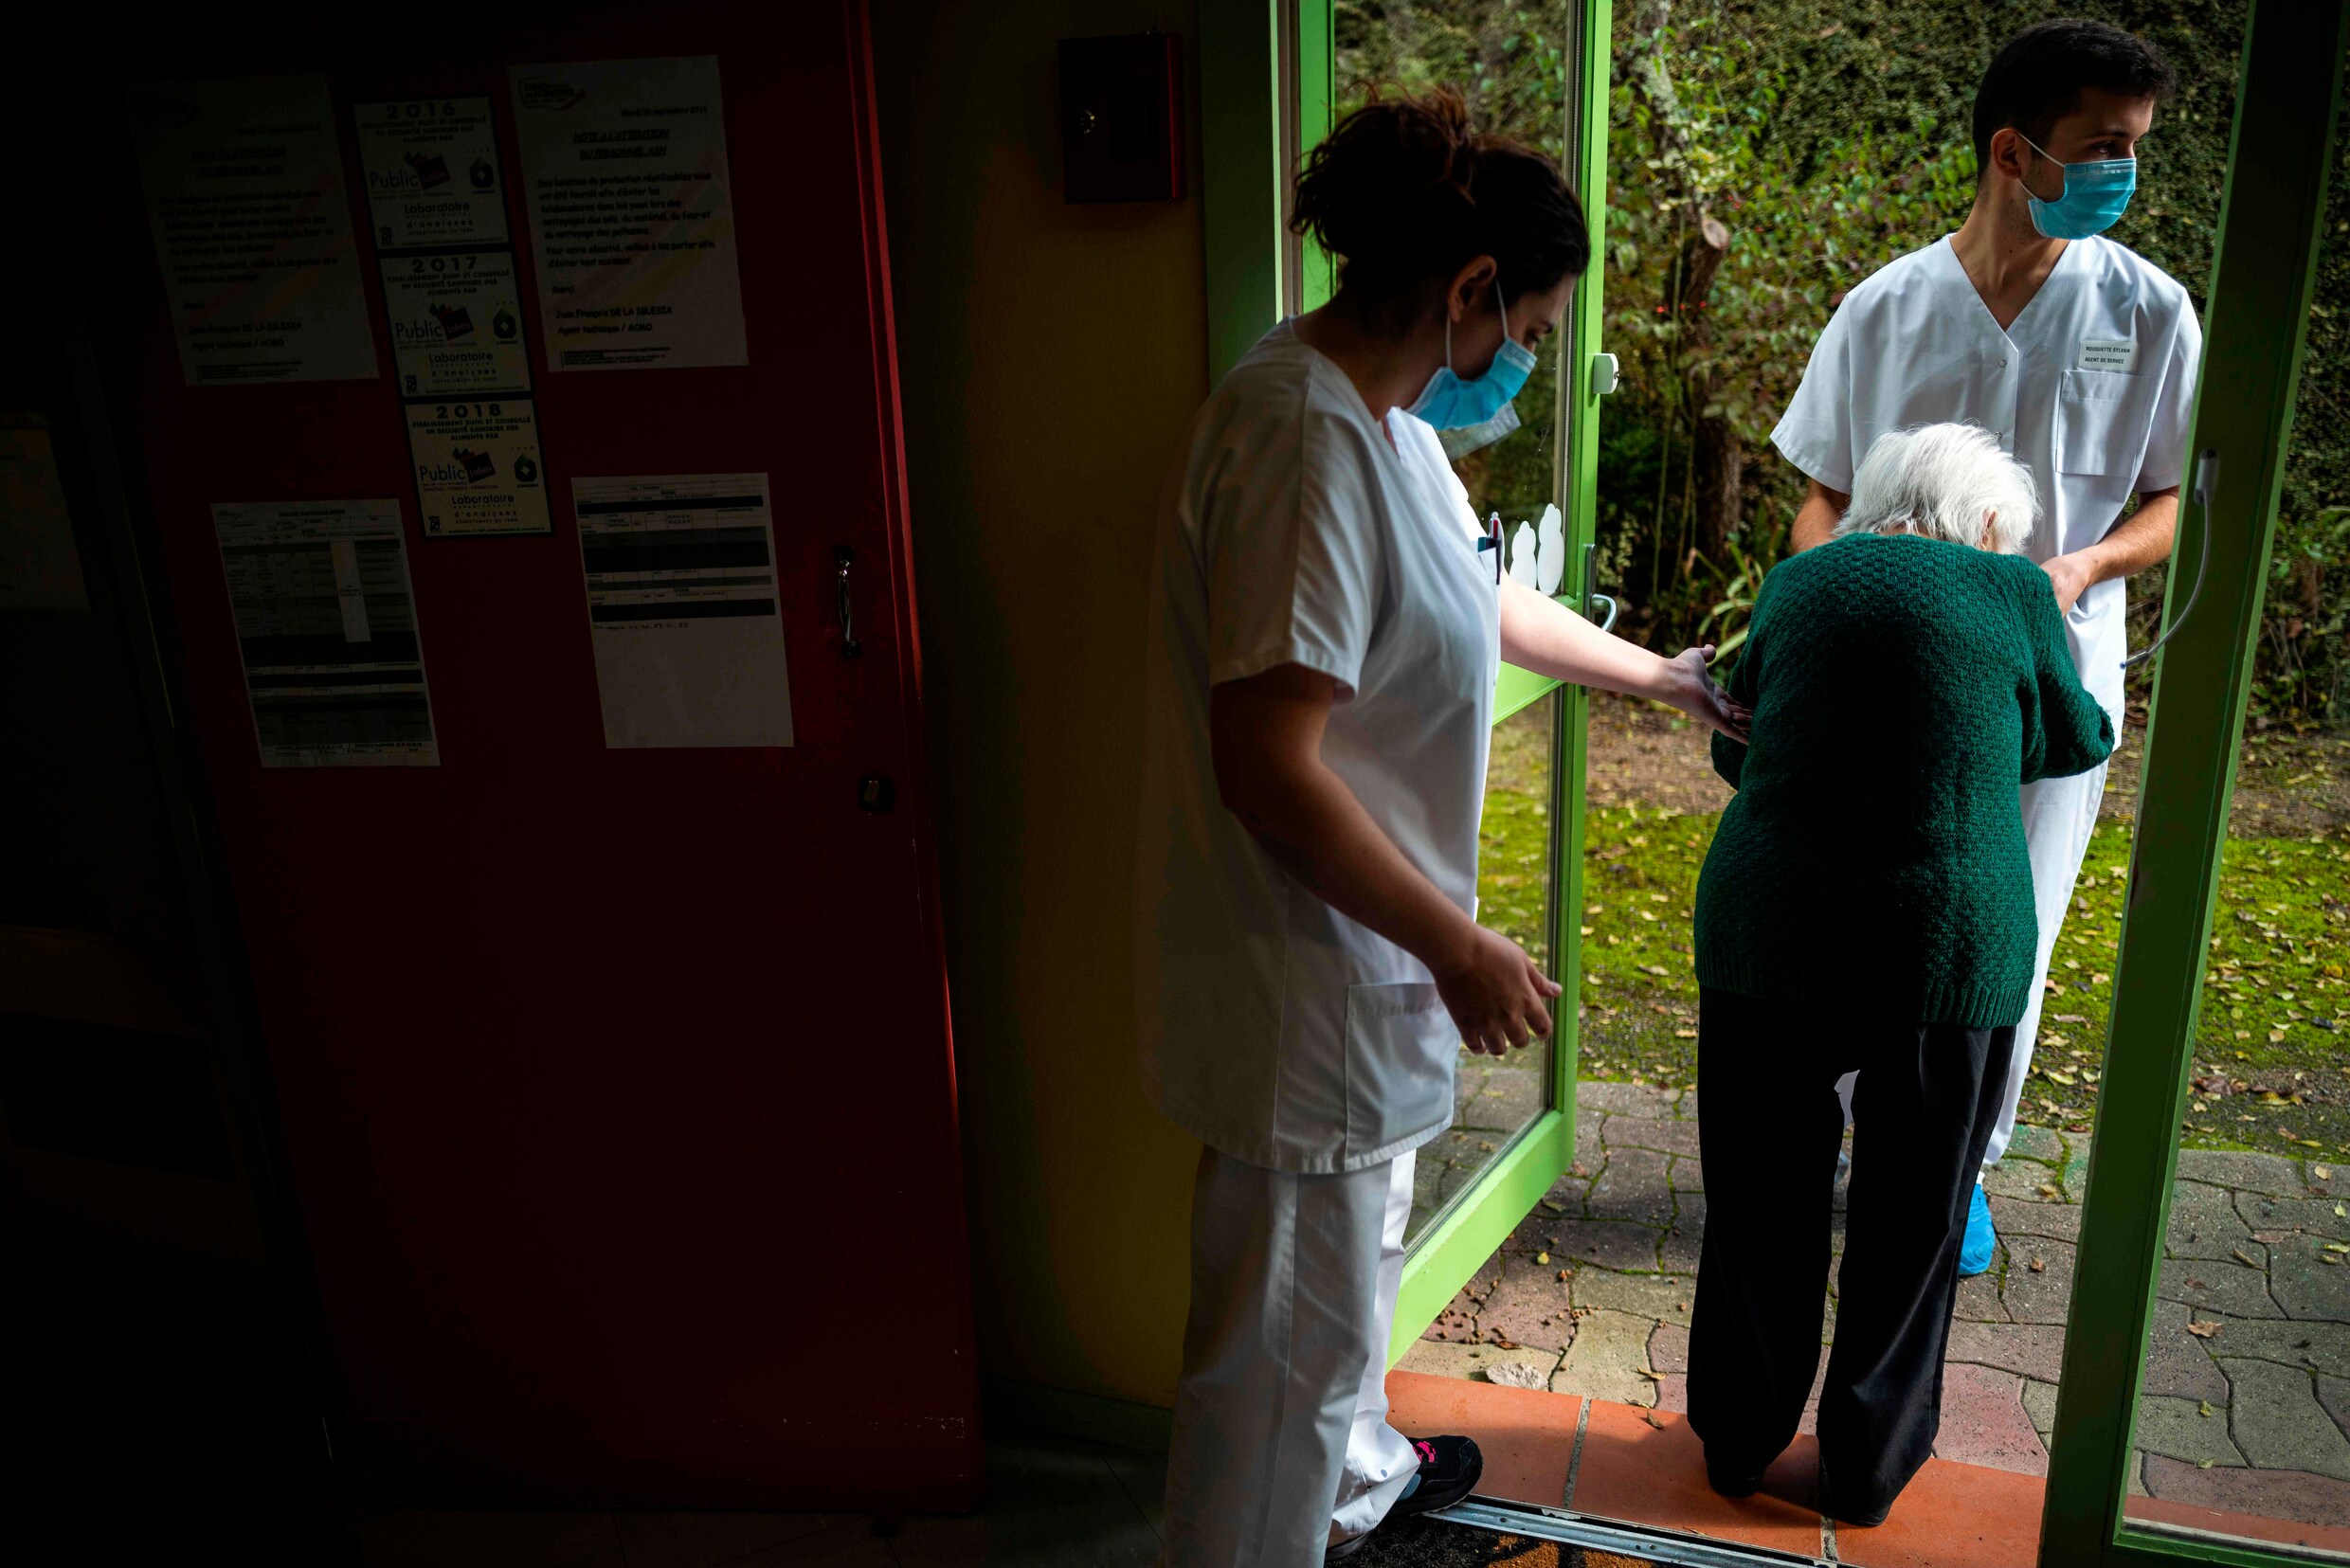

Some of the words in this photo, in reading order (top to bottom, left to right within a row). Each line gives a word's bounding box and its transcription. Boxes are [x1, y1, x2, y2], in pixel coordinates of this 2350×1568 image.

[387, 101, 456, 119] 2016
[370, 170, 419, 189] Public
[423, 171, 446, 183] Labos
[405, 202, 470, 214] Laboratoire
[412, 256, 477, 273] 2017
[552, 284, 574, 294] Merci
[555, 310, 574, 319] Jean
[609, 307, 622, 316] DE
[623, 307, 634, 316] LA
[395, 319, 443, 338] Public
[446, 322, 470, 333] Labos
[558, 326, 580, 336] Agent
[628, 323, 652, 332] ACMO
[428, 351, 493, 363] Laboratoire
[432, 369, 496, 377] d'analyses
[436, 403, 501, 419] 2018
[420, 462, 466, 481] Public
[468, 465, 492, 477] Labos
[452, 494, 515, 505] Laboratoire
[454, 510, 517, 518] d'analyses
